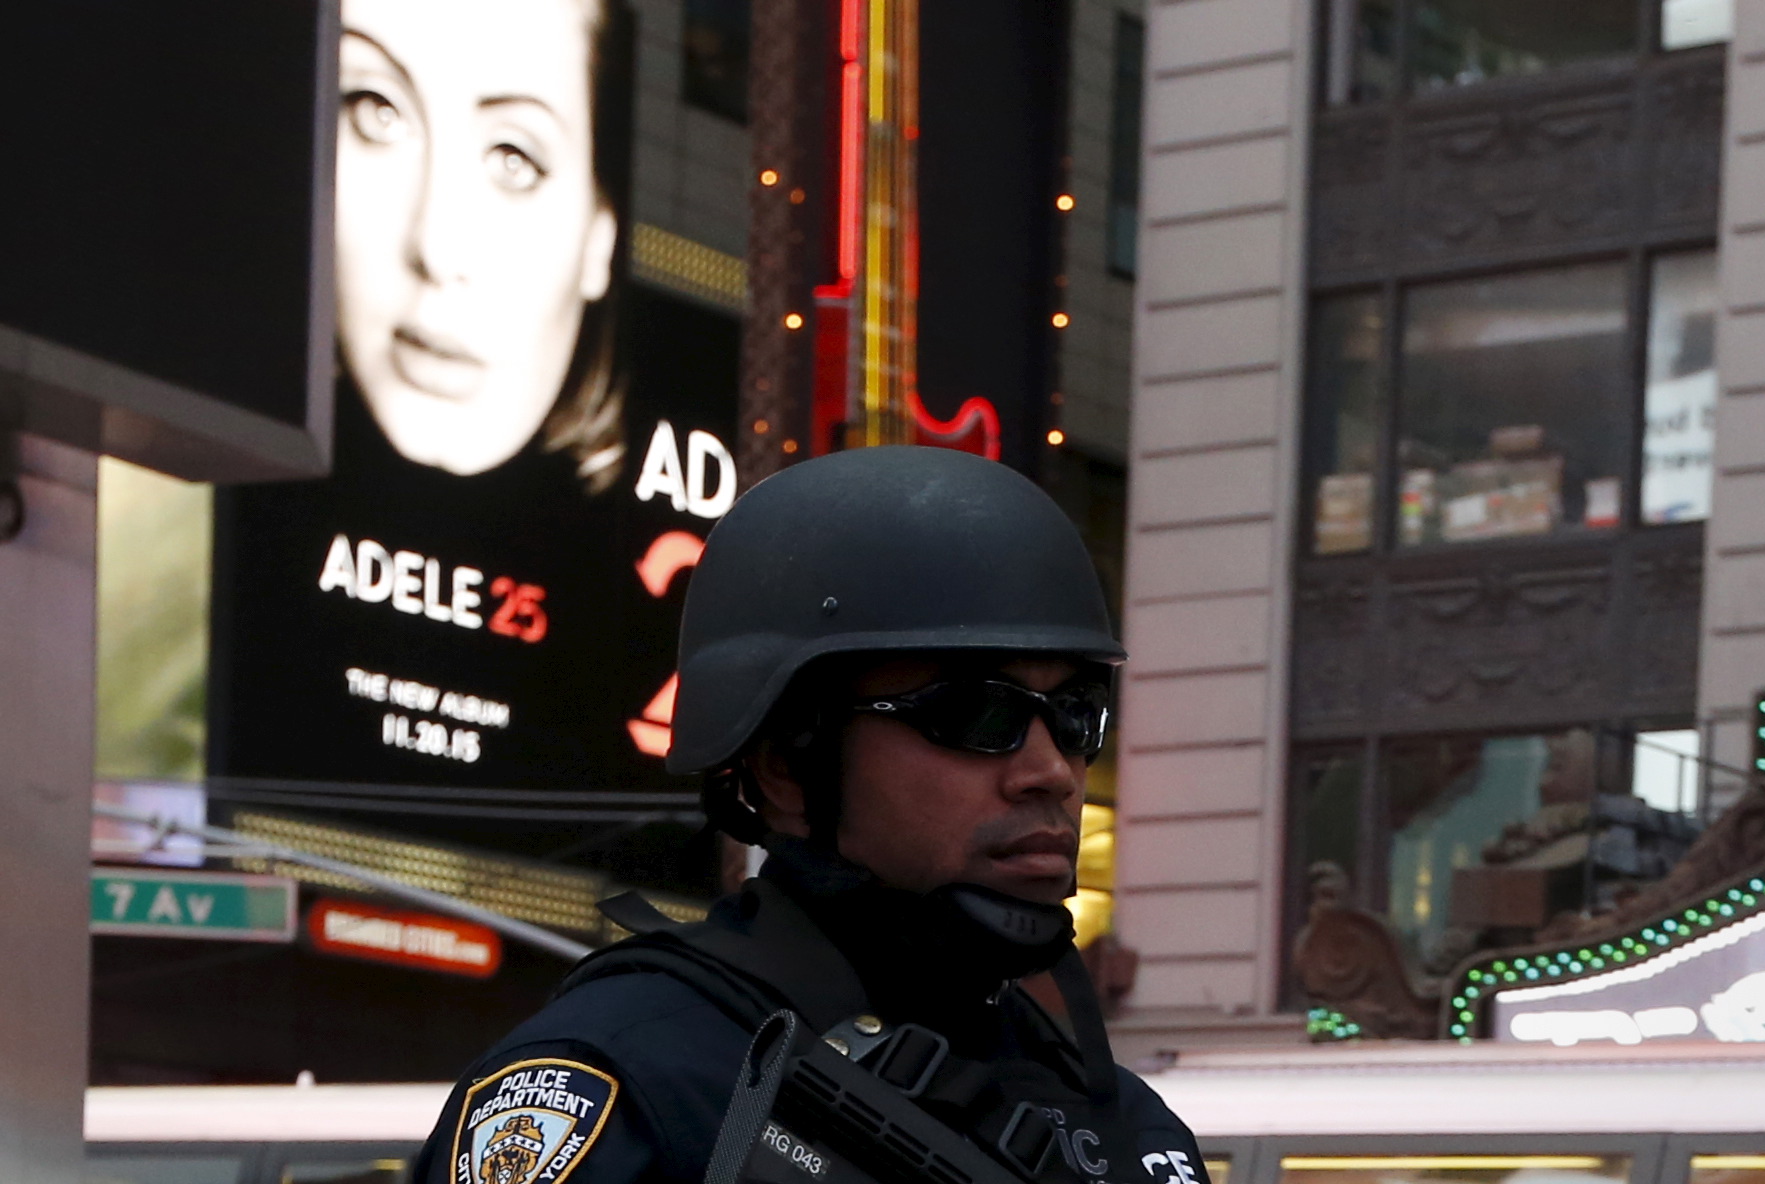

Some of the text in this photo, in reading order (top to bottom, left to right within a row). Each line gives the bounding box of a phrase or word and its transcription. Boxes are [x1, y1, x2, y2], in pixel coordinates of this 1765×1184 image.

[319, 533, 549, 643] ADELE 25
[382, 712, 483, 763] 11.20.15
[104, 881, 216, 925] 7 Av
[496, 1069, 571, 1096] POLICE
[467, 1087, 595, 1131] DEPARTMENT
[539, 1132, 585, 1181] YORK
[763, 1125, 822, 1174] RG 043
